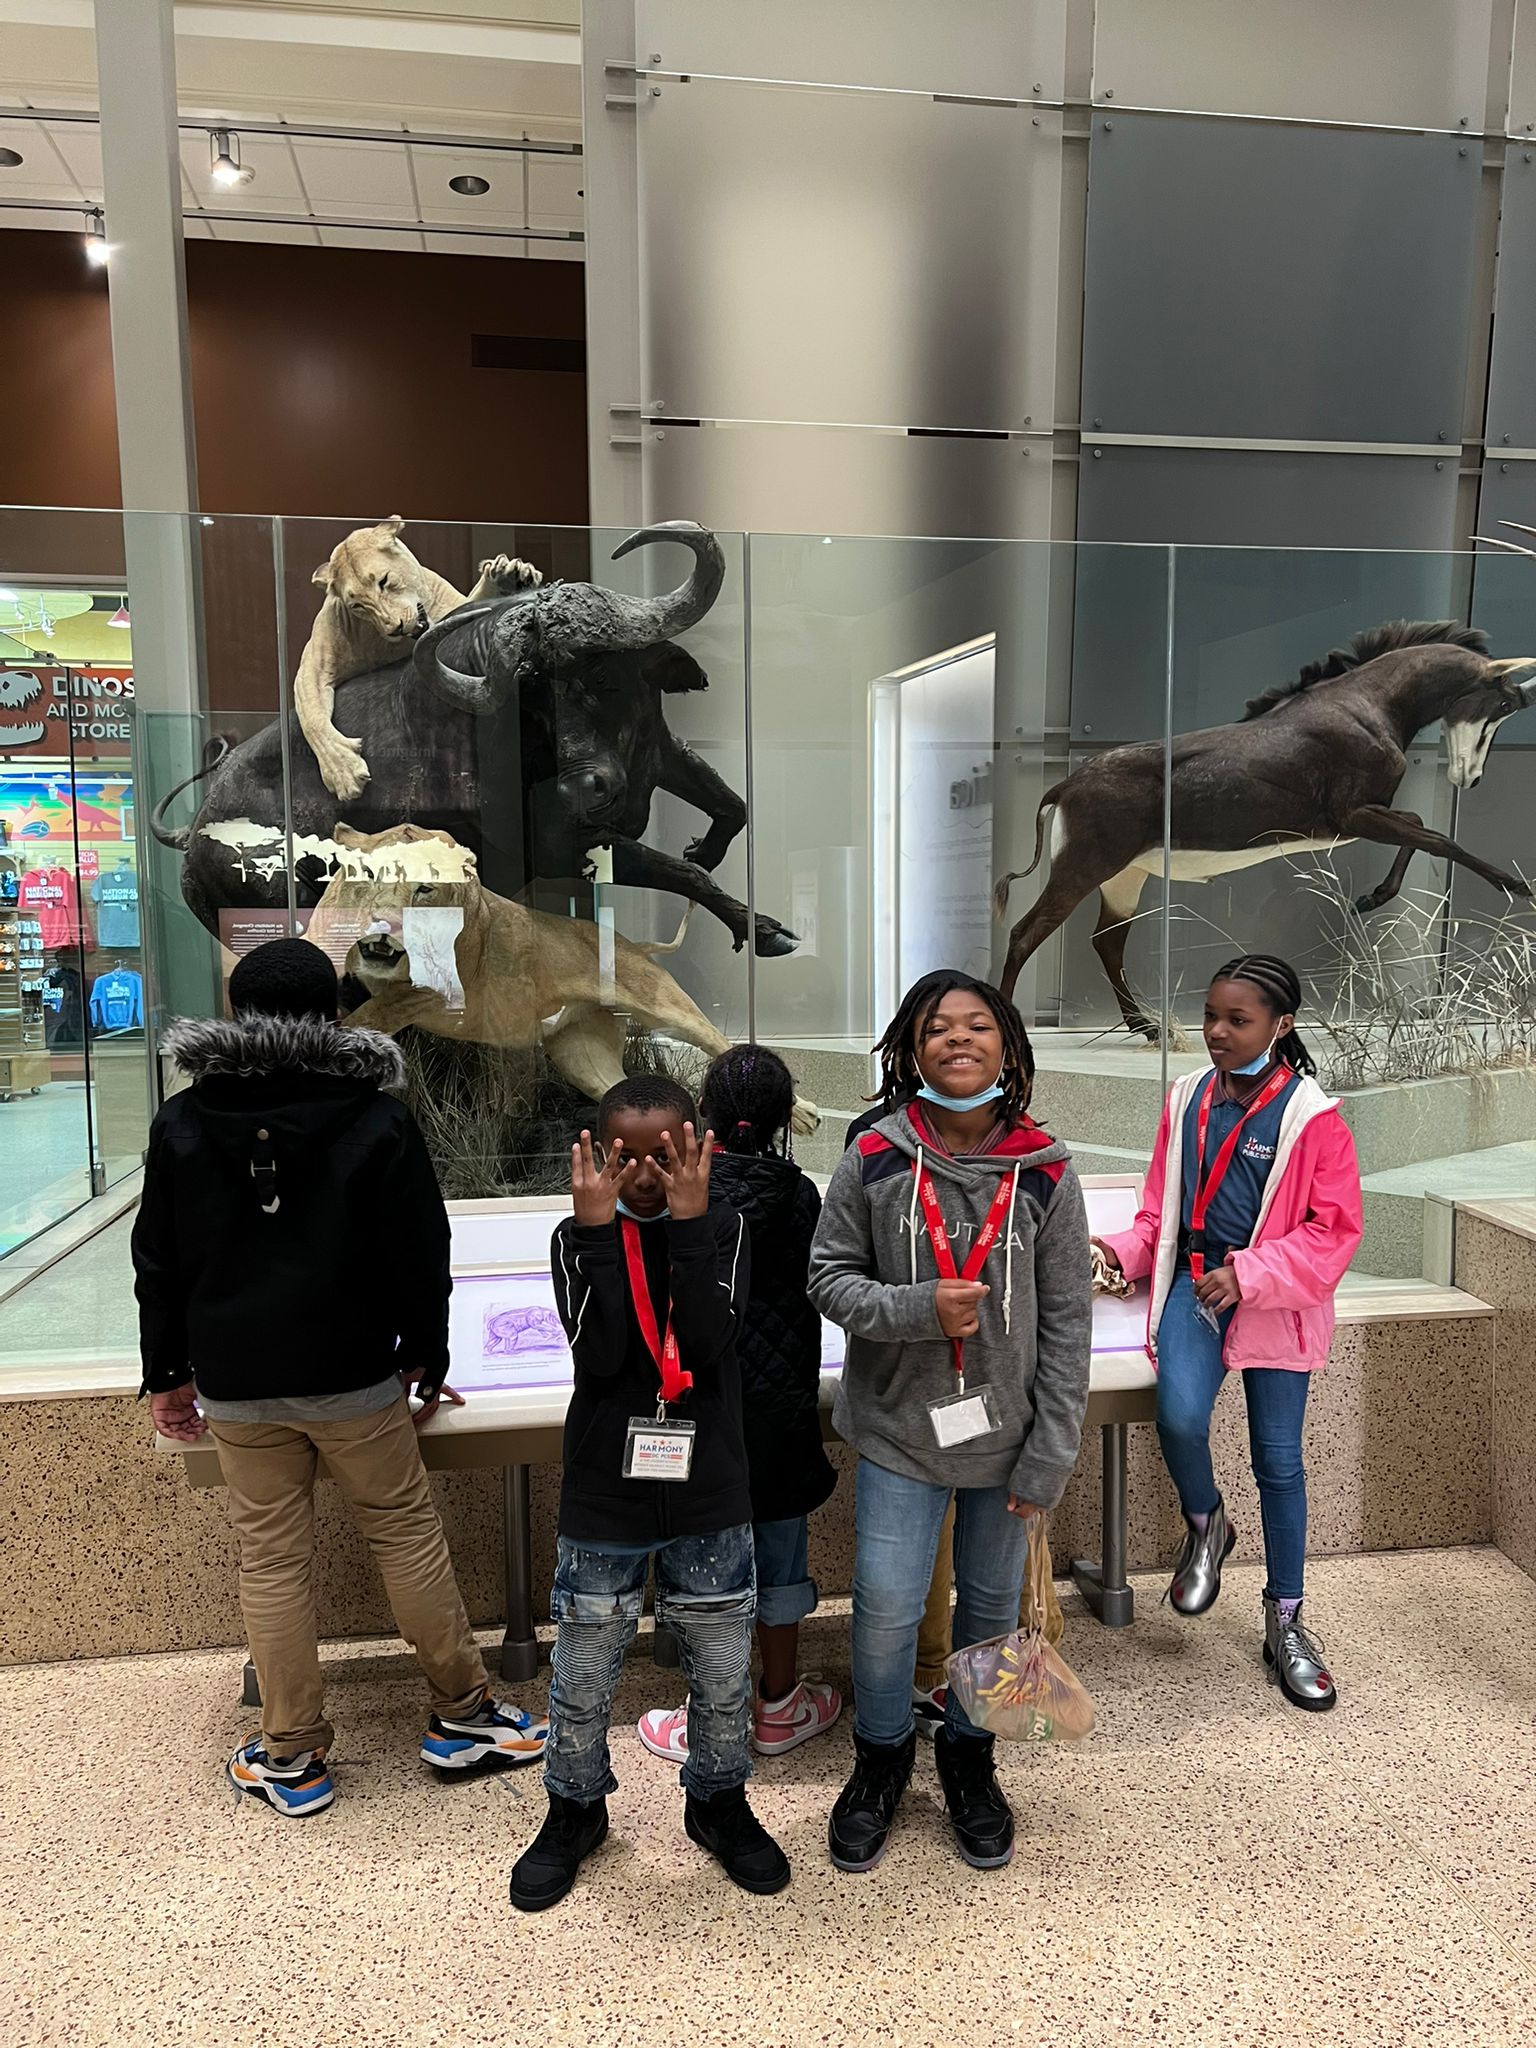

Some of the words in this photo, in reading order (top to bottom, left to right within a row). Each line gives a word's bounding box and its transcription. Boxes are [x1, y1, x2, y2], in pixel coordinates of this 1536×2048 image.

[52, 677, 135, 697] DINOS
[46, 703, 88, 717] AND
[95, 703, 128, 718] MO
[71, 723, 131, 738] STORE
[1244, 1136, 1276, 1154] HARMO
[898, 1214, 1025, 1251] NAUTCA
[639, 1444, 684, 1453] HARMONY
